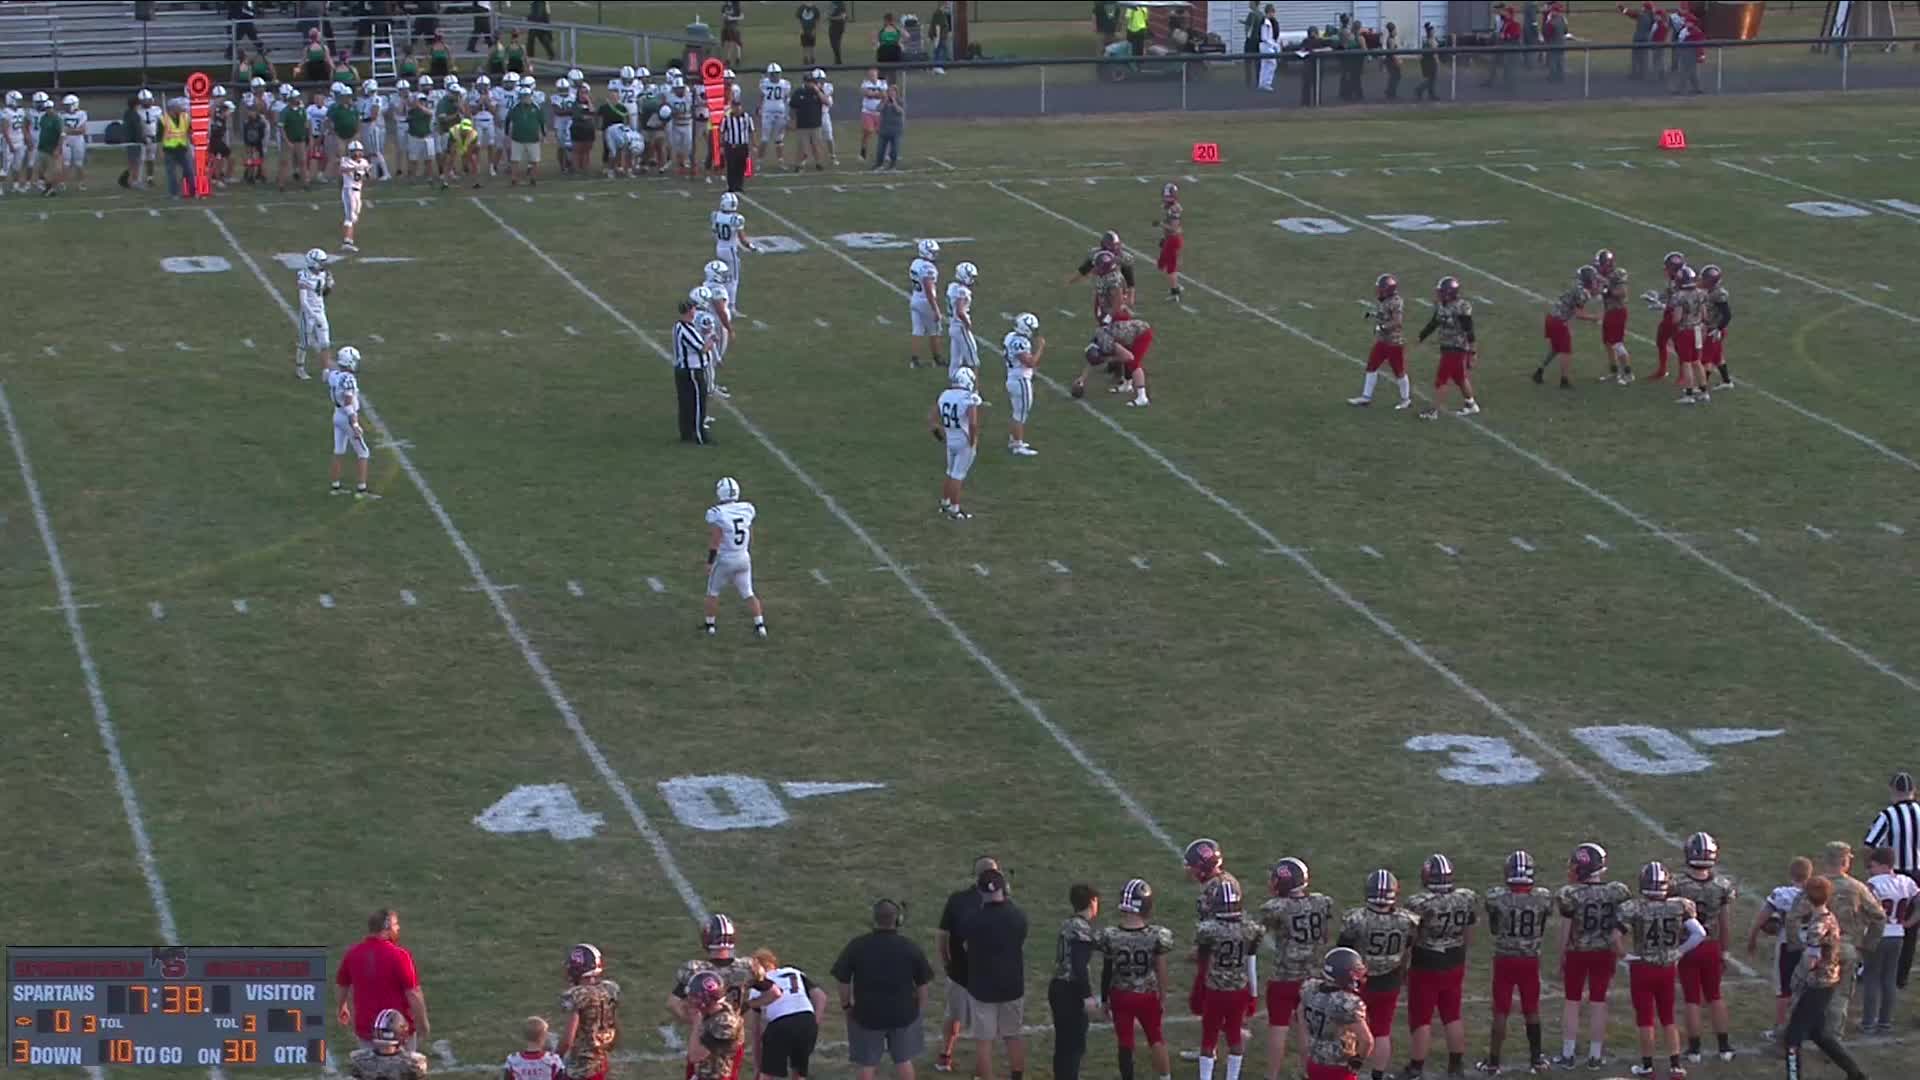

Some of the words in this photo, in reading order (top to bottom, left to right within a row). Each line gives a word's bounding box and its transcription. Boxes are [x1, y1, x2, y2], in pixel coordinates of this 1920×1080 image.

[621, 89, 635, 104] 72
[765, 86, 783, 100] 70
[145, 110, 151, 125] 1
[1197, 145, 1215, 160] 20
[940, 402, 960, 428] 64
[732, 517, 746, 546] 5
[1292, 911, 1321, 943] 58
[1507, 909, 1535, 937] 18
[1583, 903, 1614, 932] 62
[1368, 932, 1401, 956] 50
[1646, 917, 1677, 946] 45
[1116, 949, 1149, 976] 29
[1219, 940, 1244, 967] 21
